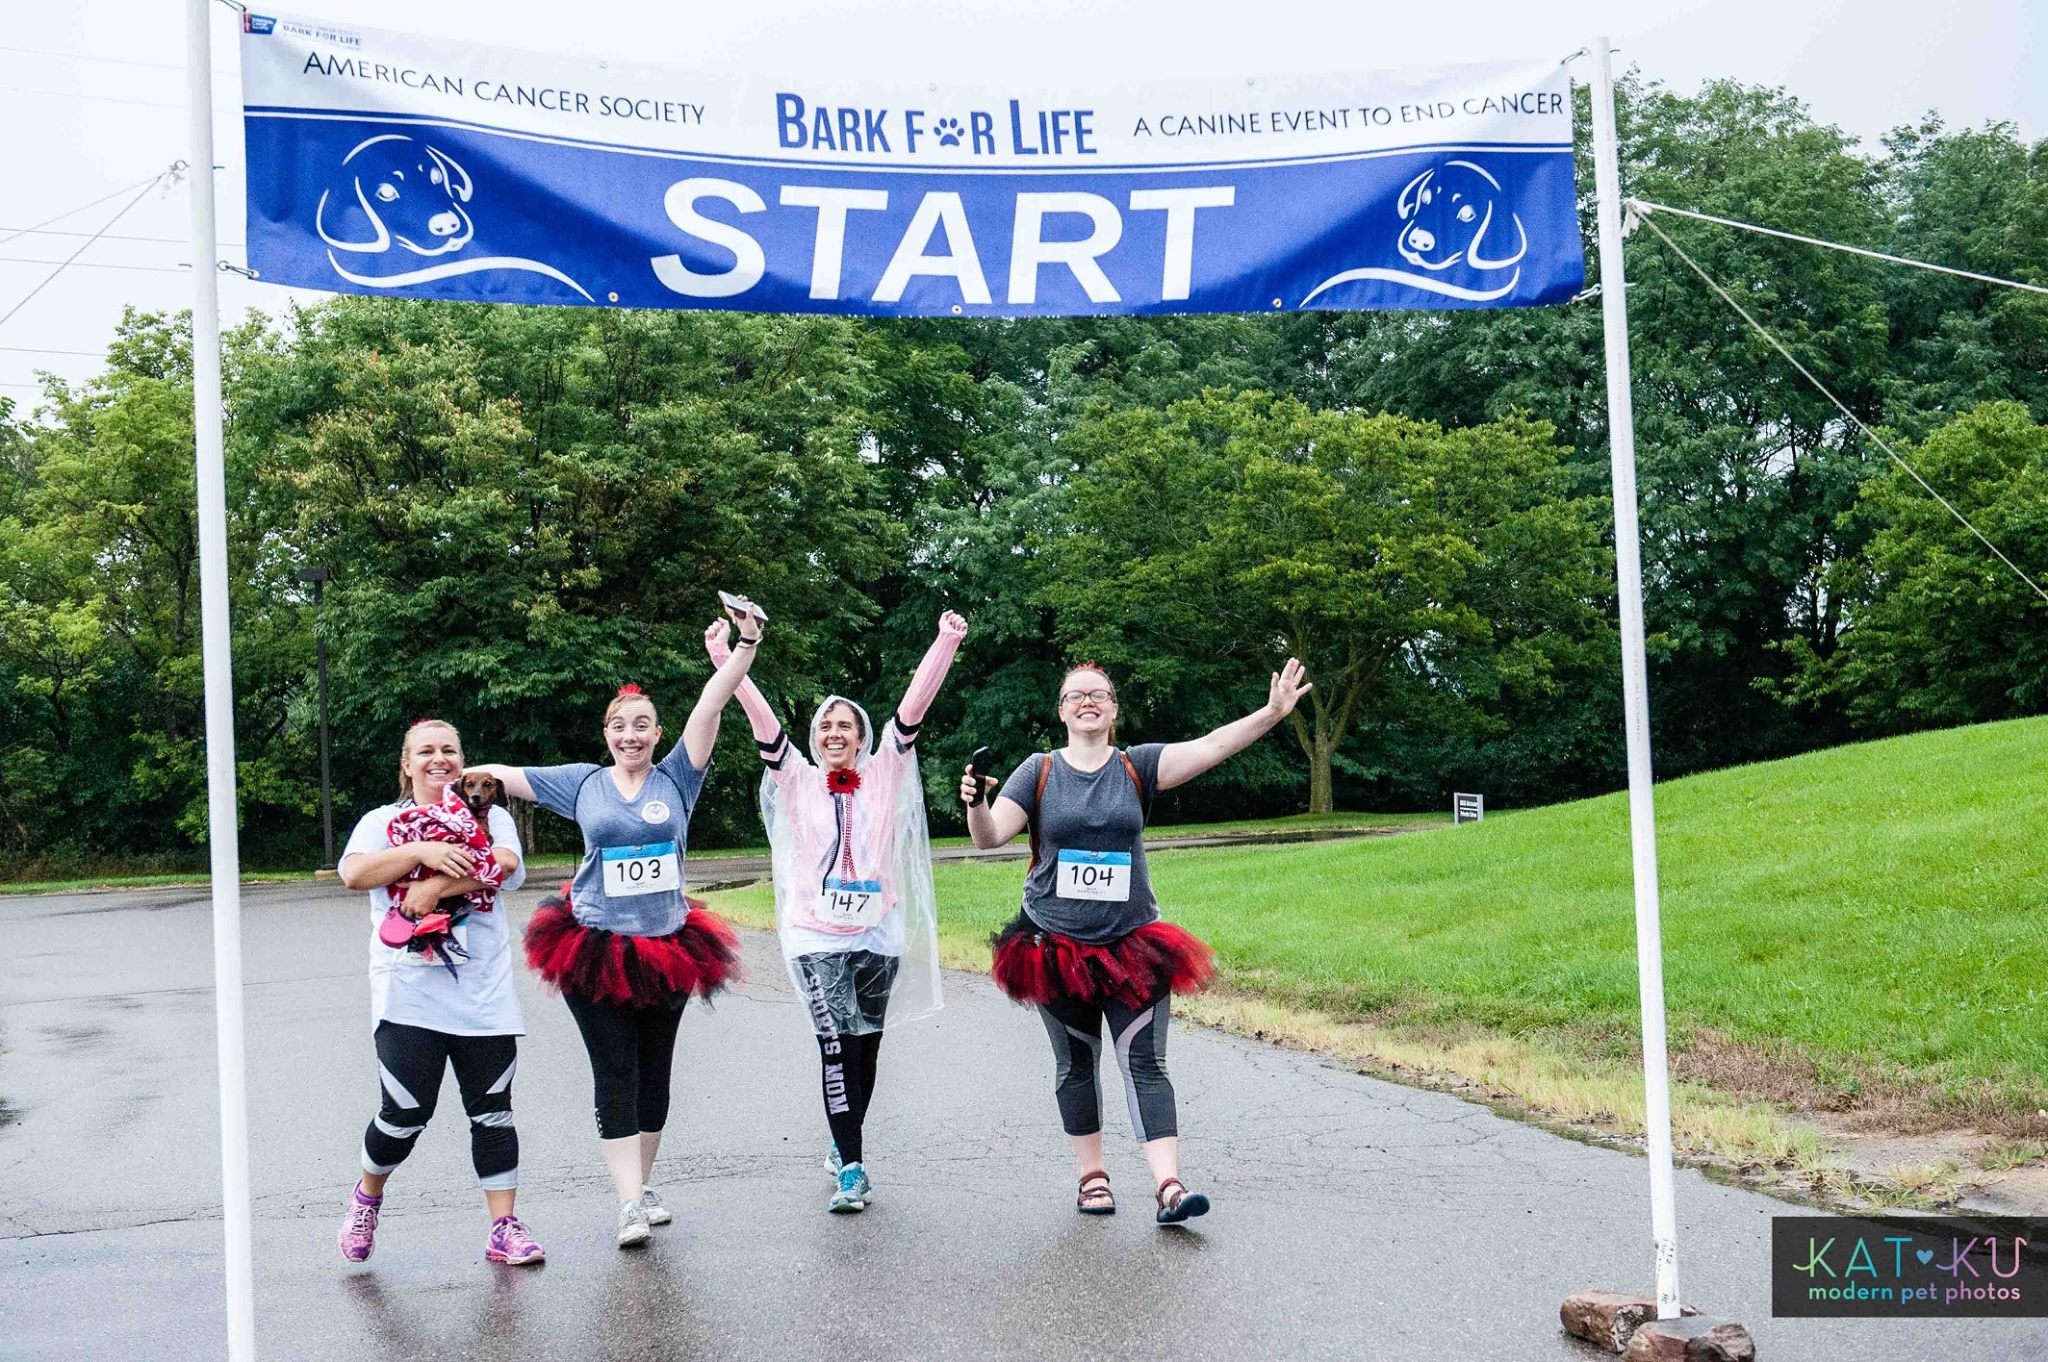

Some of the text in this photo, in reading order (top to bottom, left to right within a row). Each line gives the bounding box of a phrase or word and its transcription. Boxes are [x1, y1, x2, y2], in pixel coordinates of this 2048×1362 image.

[303, 51, 705, 125] AMERICAN CANCER SOCIETY
[1133, 92, 1563, 137] A CANINE EVENT TO END CANCER
[651, 177, 1235, 305] START
[616, 858, 661, 883] 103
[1071, 864, 1115, 887] 104
[830, 891, 870, 913] 147
[805, 973, 850, 1115] SPORTS MOM
